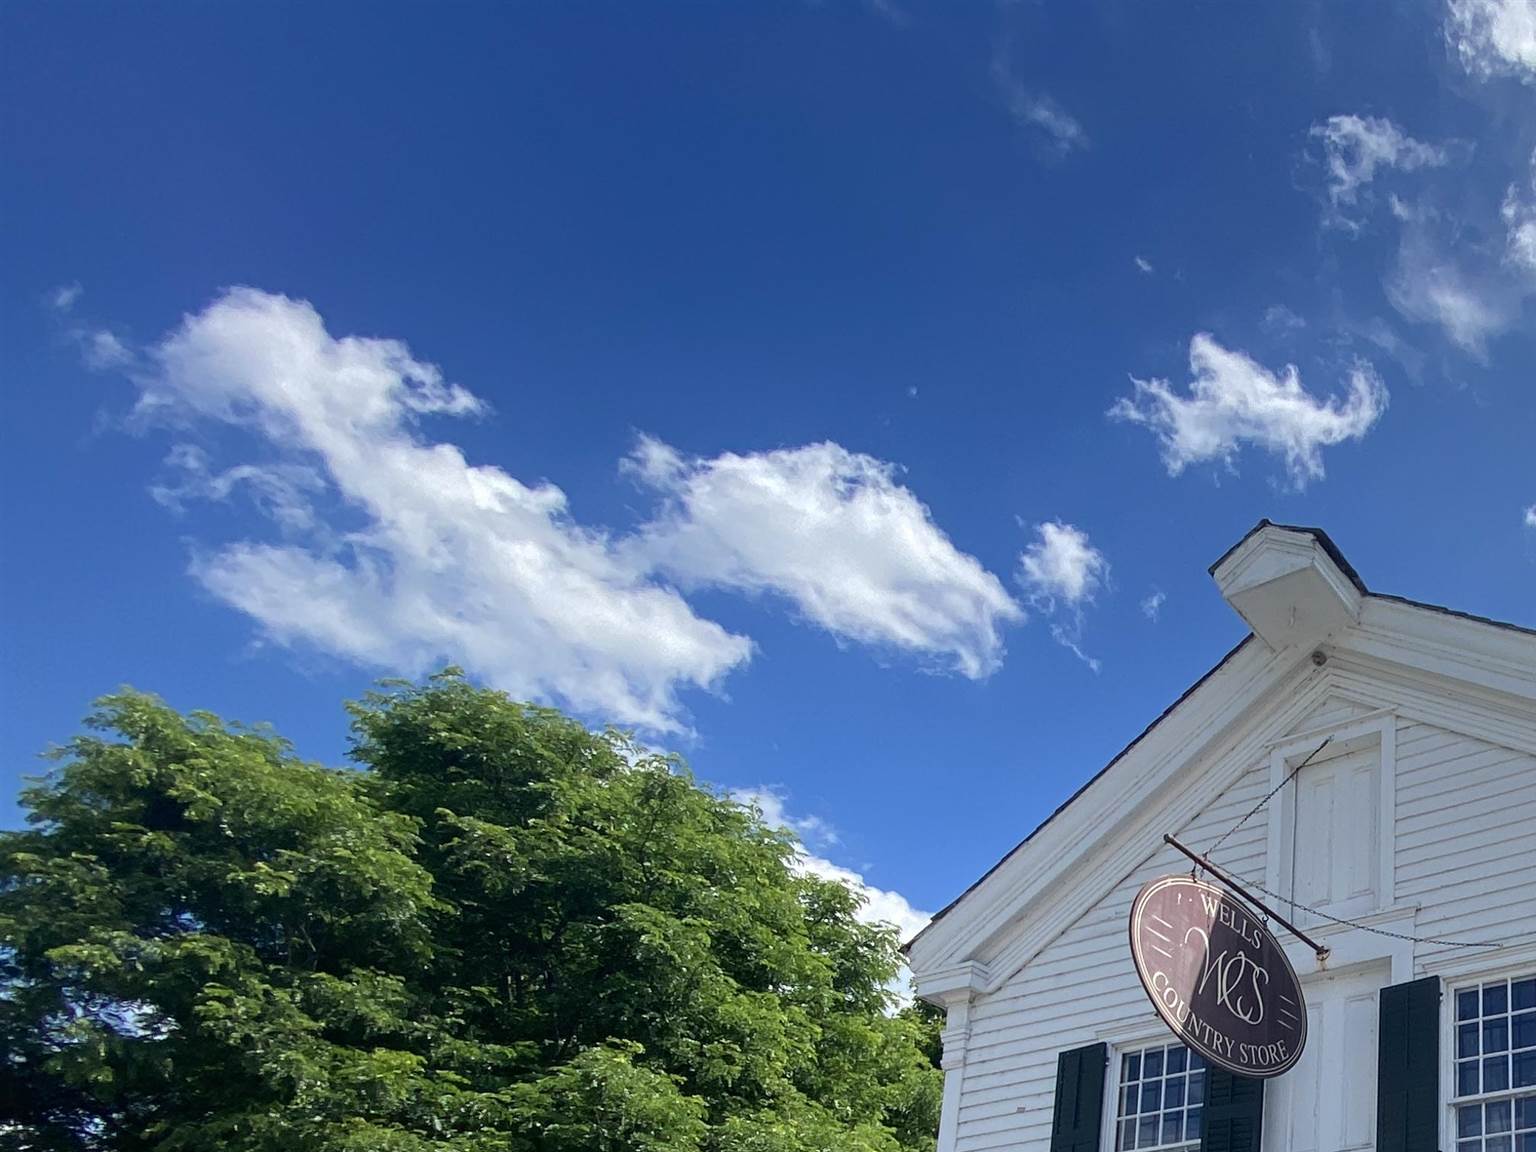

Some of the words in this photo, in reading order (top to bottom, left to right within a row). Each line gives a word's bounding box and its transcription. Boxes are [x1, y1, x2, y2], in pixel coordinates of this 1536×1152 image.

[1200, 893, 1263, 949] WELLS
[1152, 971, 1235, 1058] COUNTRY
[1240, 1040, 1289, 1065] STORE
